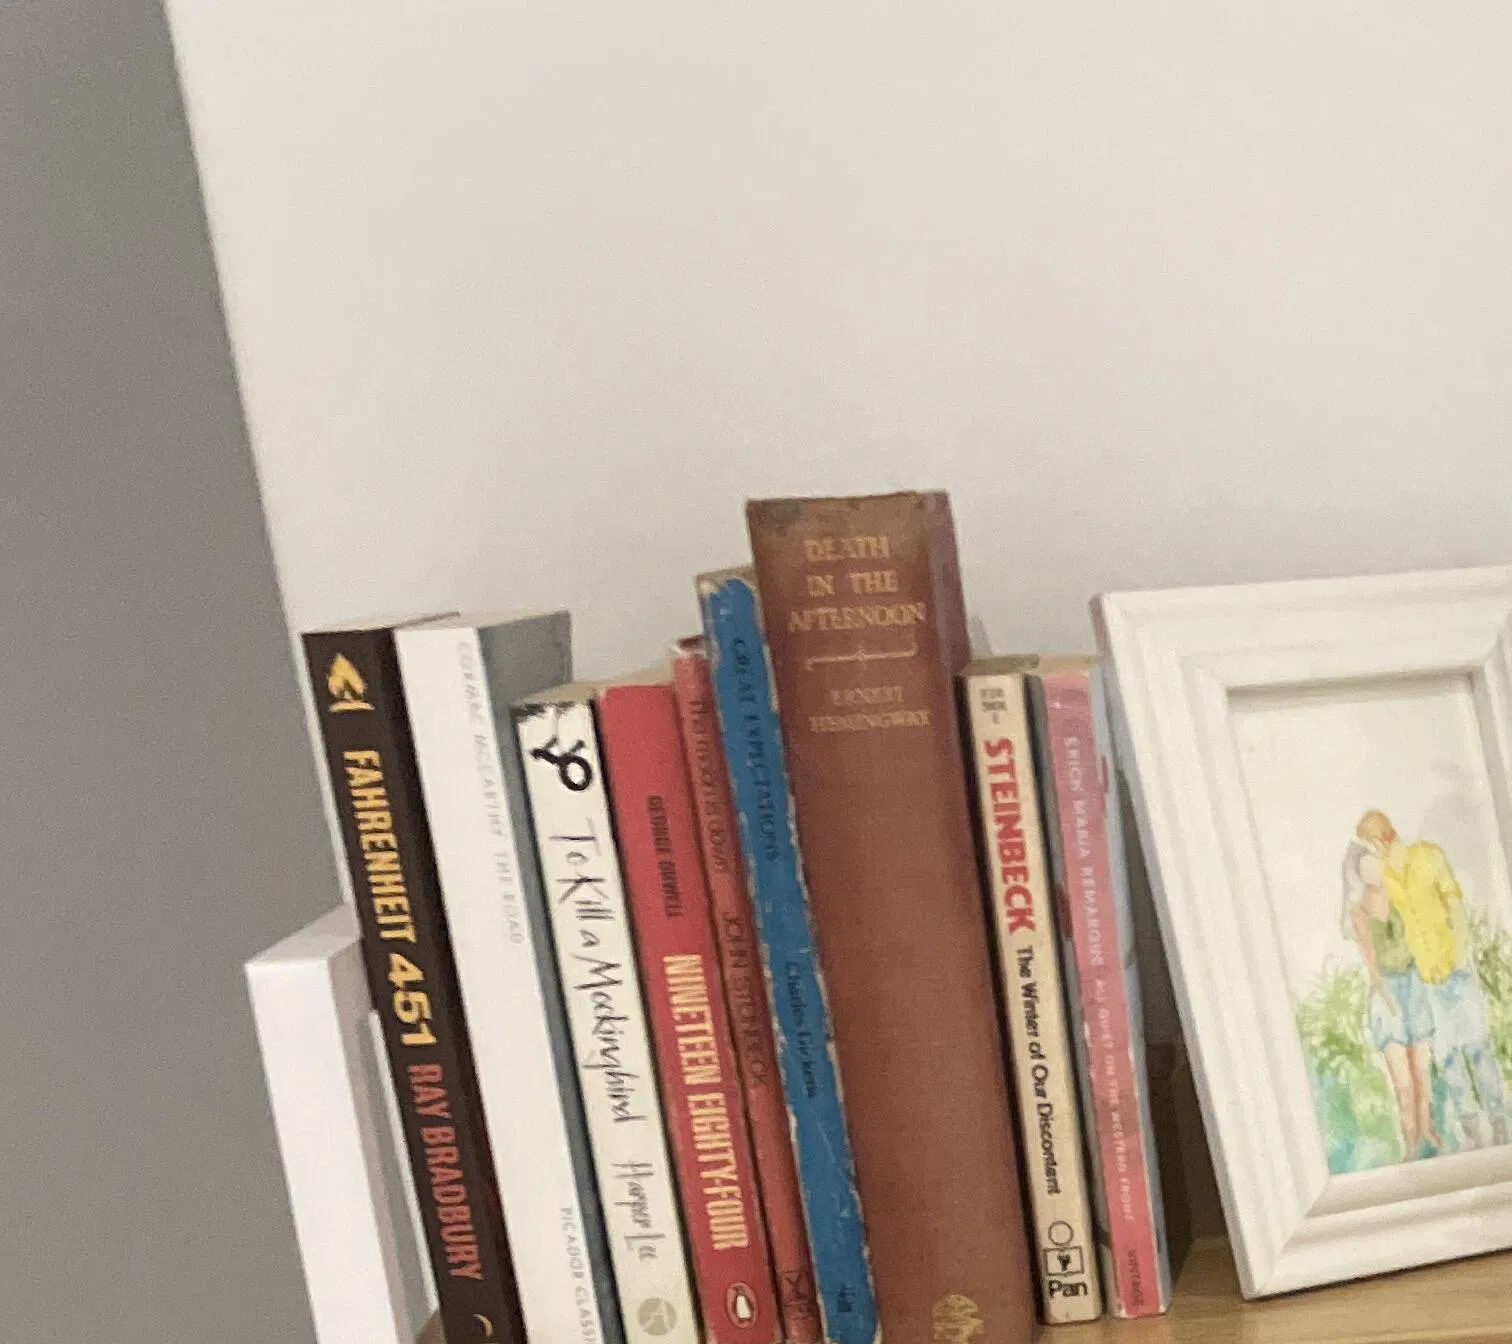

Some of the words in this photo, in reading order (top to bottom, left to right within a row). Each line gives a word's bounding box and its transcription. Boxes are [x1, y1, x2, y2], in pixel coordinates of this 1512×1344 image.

[803, 535, 891, 561] DEATH
[806, 574, 835, 597] IN
[848, 569, 899, 594] THE
[789, 602, 928, 633] AFTERNOON
[1063, 735, 1082, 793] ERICH
[548, 817, 602, 864] To
[647, 794, 672, 854] GEORGE
[983, 735, 1037, 935] STEINBECK
[1071, 798, 1091, 858] MARIA
[343, 749, 417, 945] FAHRENHEIT
[387, 952, 438, 1047] 451
[554, 873, 616, 921] Kill
[658, 860, 683, 918] ORWELL
[1079, 865, 1105, 968] REMARQUE
[578, 929, 602, 948] a
[1014, 945, 1038, 980] The
[568, 952, 649, 1123] Mockingbird
[663, 953, 723, 1086] NINETEEN
[1017, 980, 1047, 1039] Winter
[1028, 1040, 1047, 1061] of
[407, 1063, 453, 1121] RAY
[1029, 1063, 1053, 1100] Our
[687, 1092, 750, 1252] EIGHTY-FOUR
[1036, 1101, 1062, 1196] Discontent
[420, 1125, 483, 1282] BRADBURY
[611, 1160, 656, 1229] Harper
[559, 1205, 585, 1280] PICADOR
[623, 1232, 667, 1262] Lee
[1048, 1279, 1088, 1299] Pan
